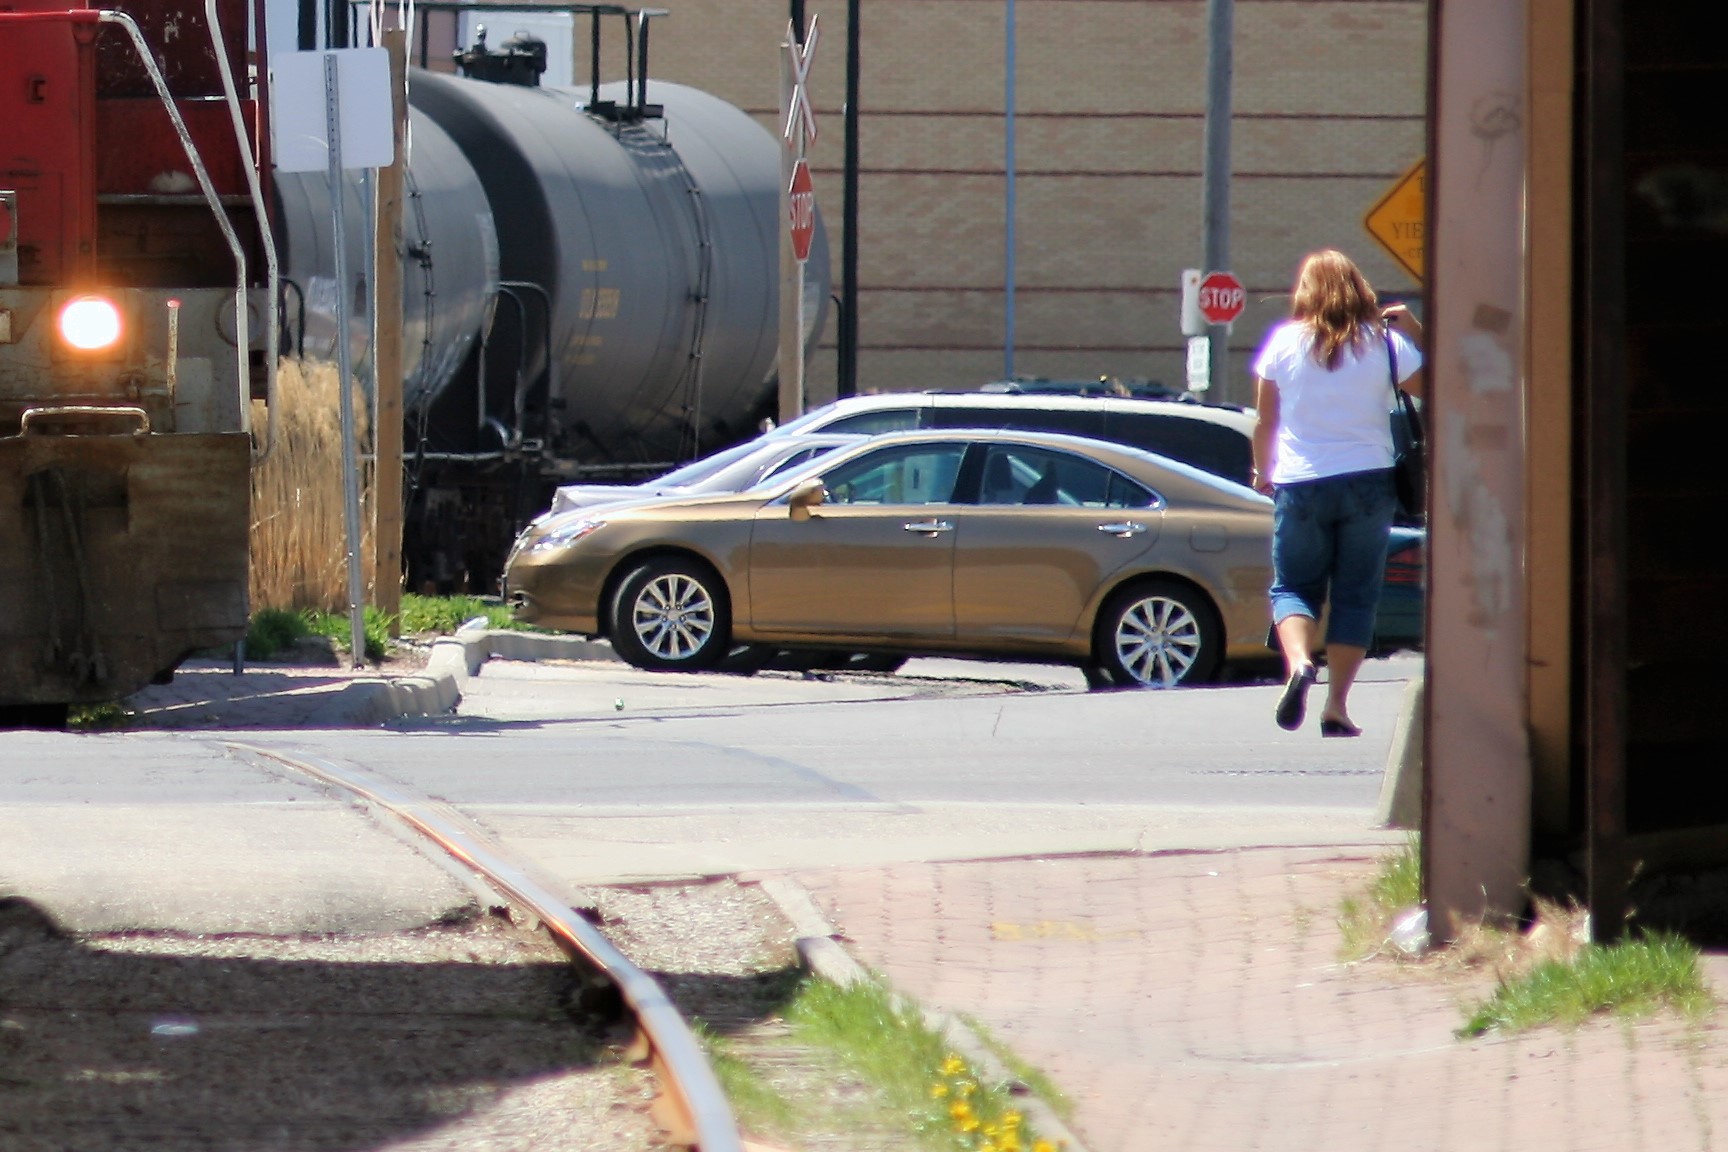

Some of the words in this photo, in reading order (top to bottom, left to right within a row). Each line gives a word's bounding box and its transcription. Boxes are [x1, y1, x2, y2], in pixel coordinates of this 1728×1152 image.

[790, 192, 814, 231] STOP
[1392, 222, 1424, 240] YIE
[1199, 286, 1244, 310] STOP
